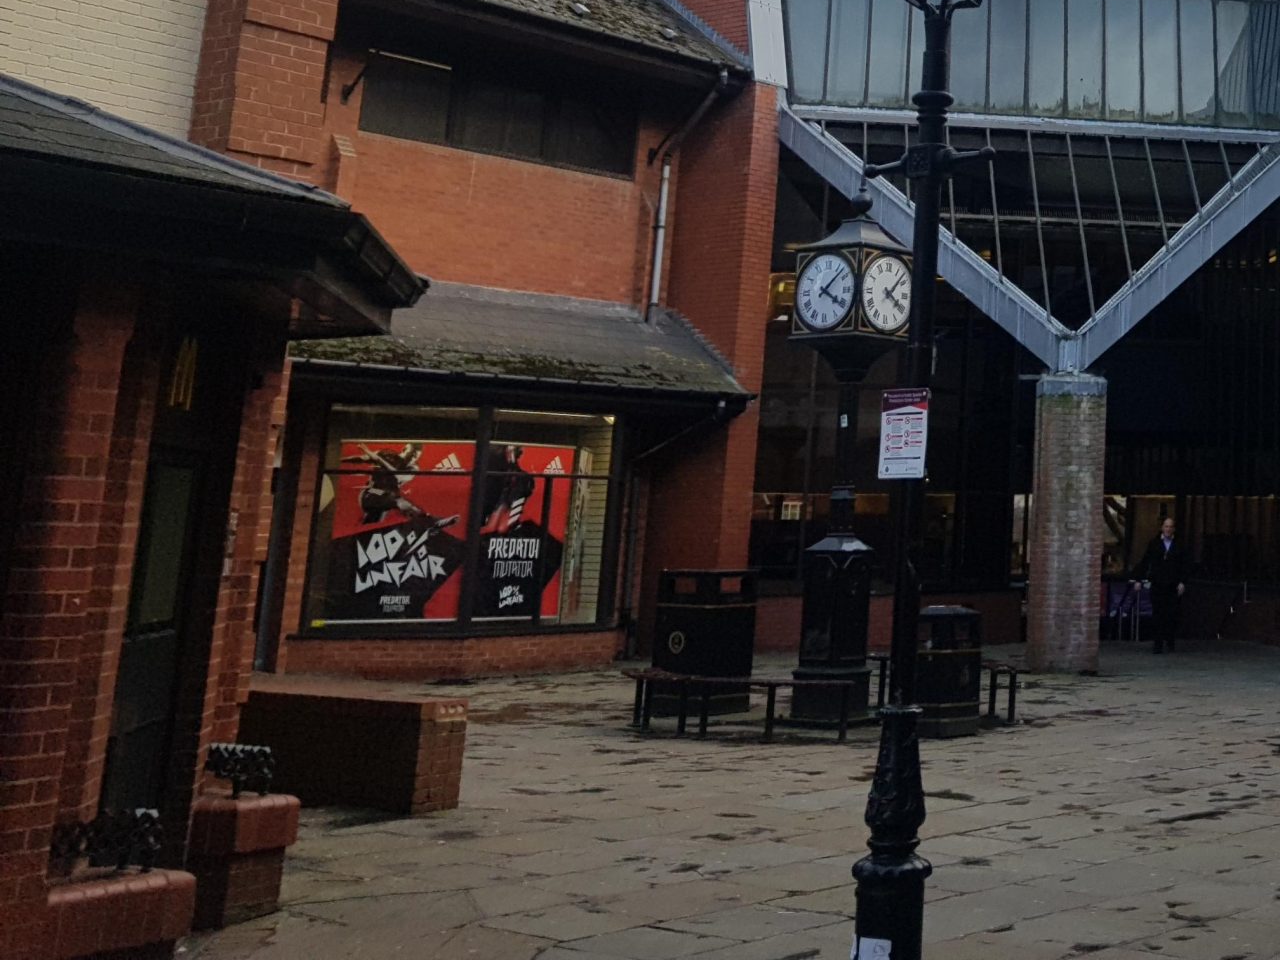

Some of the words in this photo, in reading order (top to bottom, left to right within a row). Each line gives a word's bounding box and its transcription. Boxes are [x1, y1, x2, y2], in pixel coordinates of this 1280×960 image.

[357, 528, 429, 569] 100%
[355, 553, 447, 593] UNFAIR
[492, 560, 533, 579] MUTATOR
[499, 585, 520, 600] 100%
